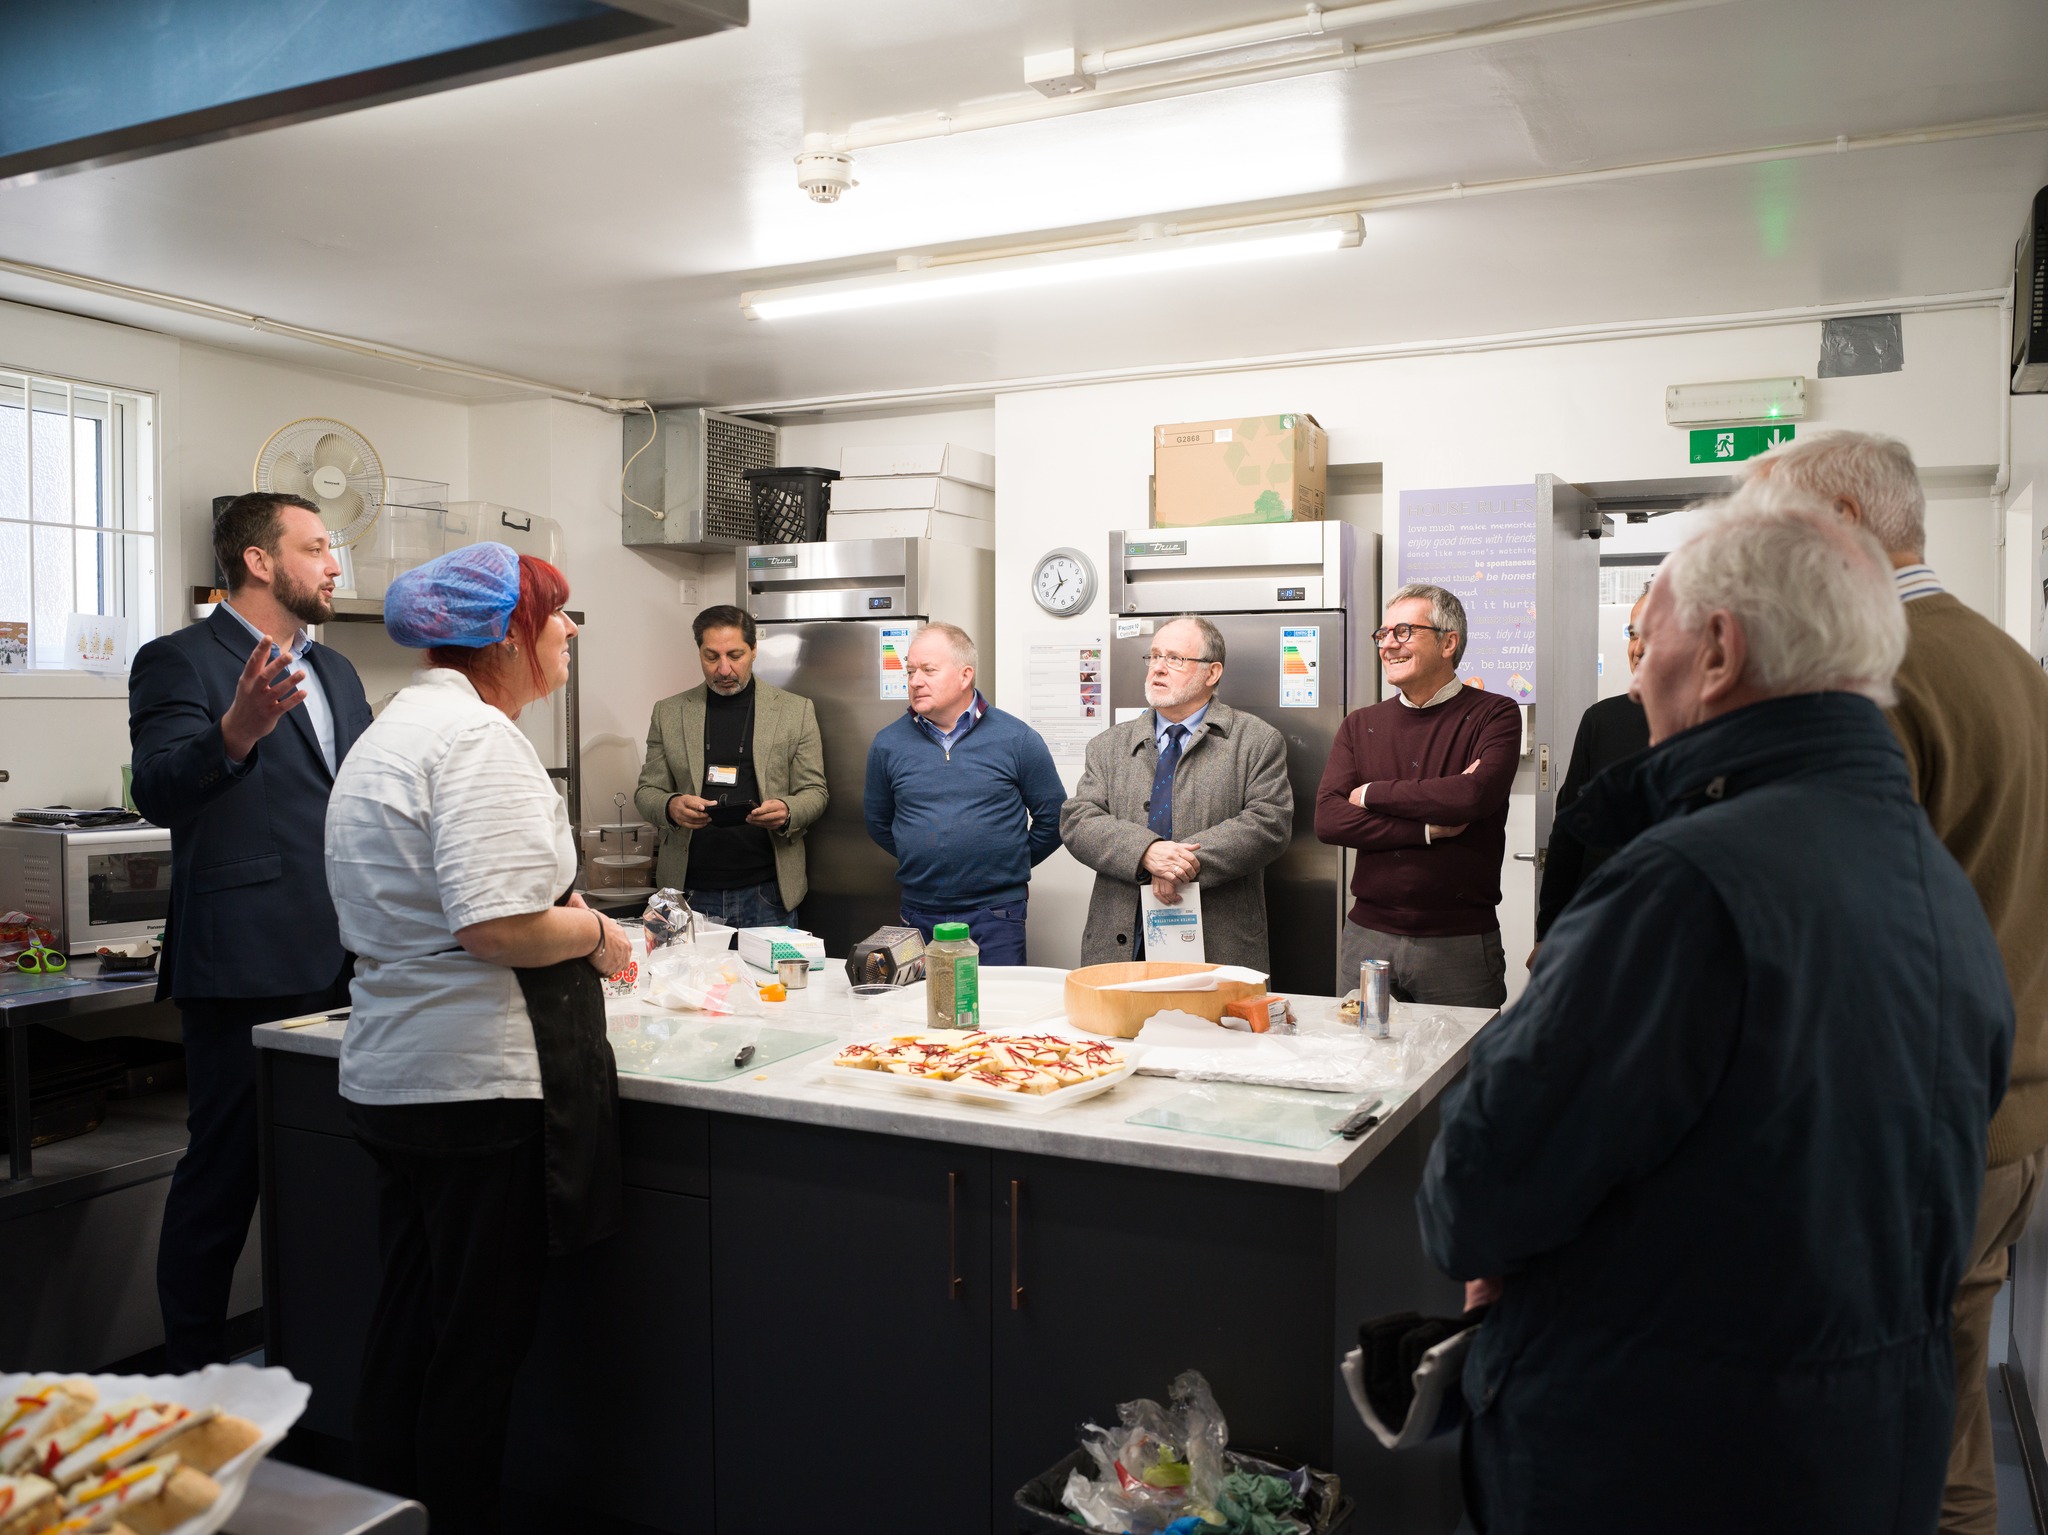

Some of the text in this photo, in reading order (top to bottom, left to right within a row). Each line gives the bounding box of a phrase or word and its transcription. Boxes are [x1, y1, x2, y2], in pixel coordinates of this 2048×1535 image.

[1177, 435, 1199, 443] G2868
[1408, 498, 1536, 517] HOUSE RULES
[1407, 521, 1536, 533] love much make memories
[1408, 533, 1536, 549] enjoy good times with friends
[1499, 548, 1536, 556] watching
[1475, 560, 1485, 568] be
[1487, 559, 1536, 569] spontaneous
[1432, 575, 1451, 584] good
[1486, 573, 1498, 581] be
[1501, 572, 1536, 581] honest
[1483, 600, 1496, 609] it
[1503, 600, 1536, 609] hurts
[1496, 630, 1513, 641] tidy
[1514, 629, 1521, 639] it
[1523, 631, 1535, 640] up
[1501, 643, 1535, 654] smile
[1481, 660, 1494, 669] be
[1497, 660, 1534, 671] happy
